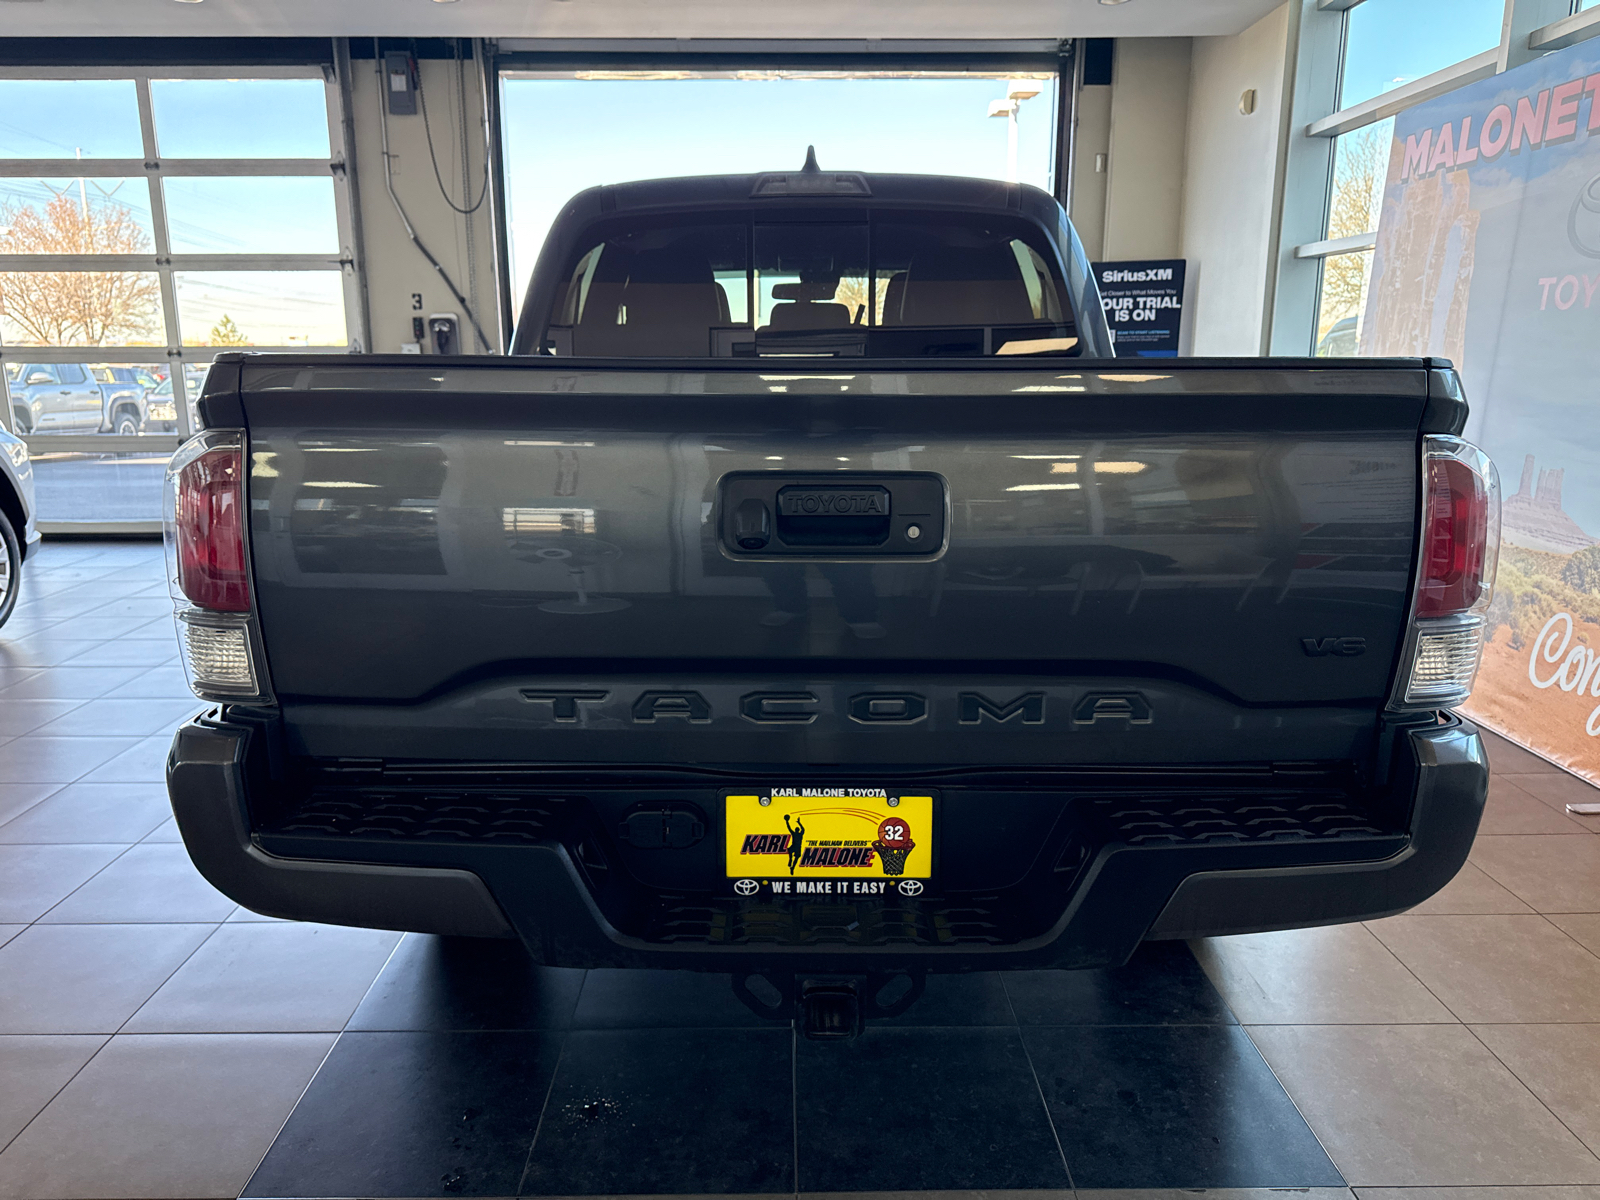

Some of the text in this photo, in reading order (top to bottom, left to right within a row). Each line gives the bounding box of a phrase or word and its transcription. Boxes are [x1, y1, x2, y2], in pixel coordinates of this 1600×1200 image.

[1102, 268, 1173, 283] SiriusXM
[412, 293, 423, 310] 3
[1101, 296, 1181, 310] OUR TRIAL
[1115, 308, 1156, 322] IS ON
[787, 494, 882, 514] TOYOTA
[1300, 636, 1366, 657] V6
[518, 688, 1153, 725] TACOMA
[771, 788, 887, 797] KARL MALONE TOYOTA
[884, 825, 904, 840] 32
[740, 834, 791, 855] KARL
[799, 847, 875, 868] MALONE
[772, 882, 886, 894] WE MAKE IT EASY
